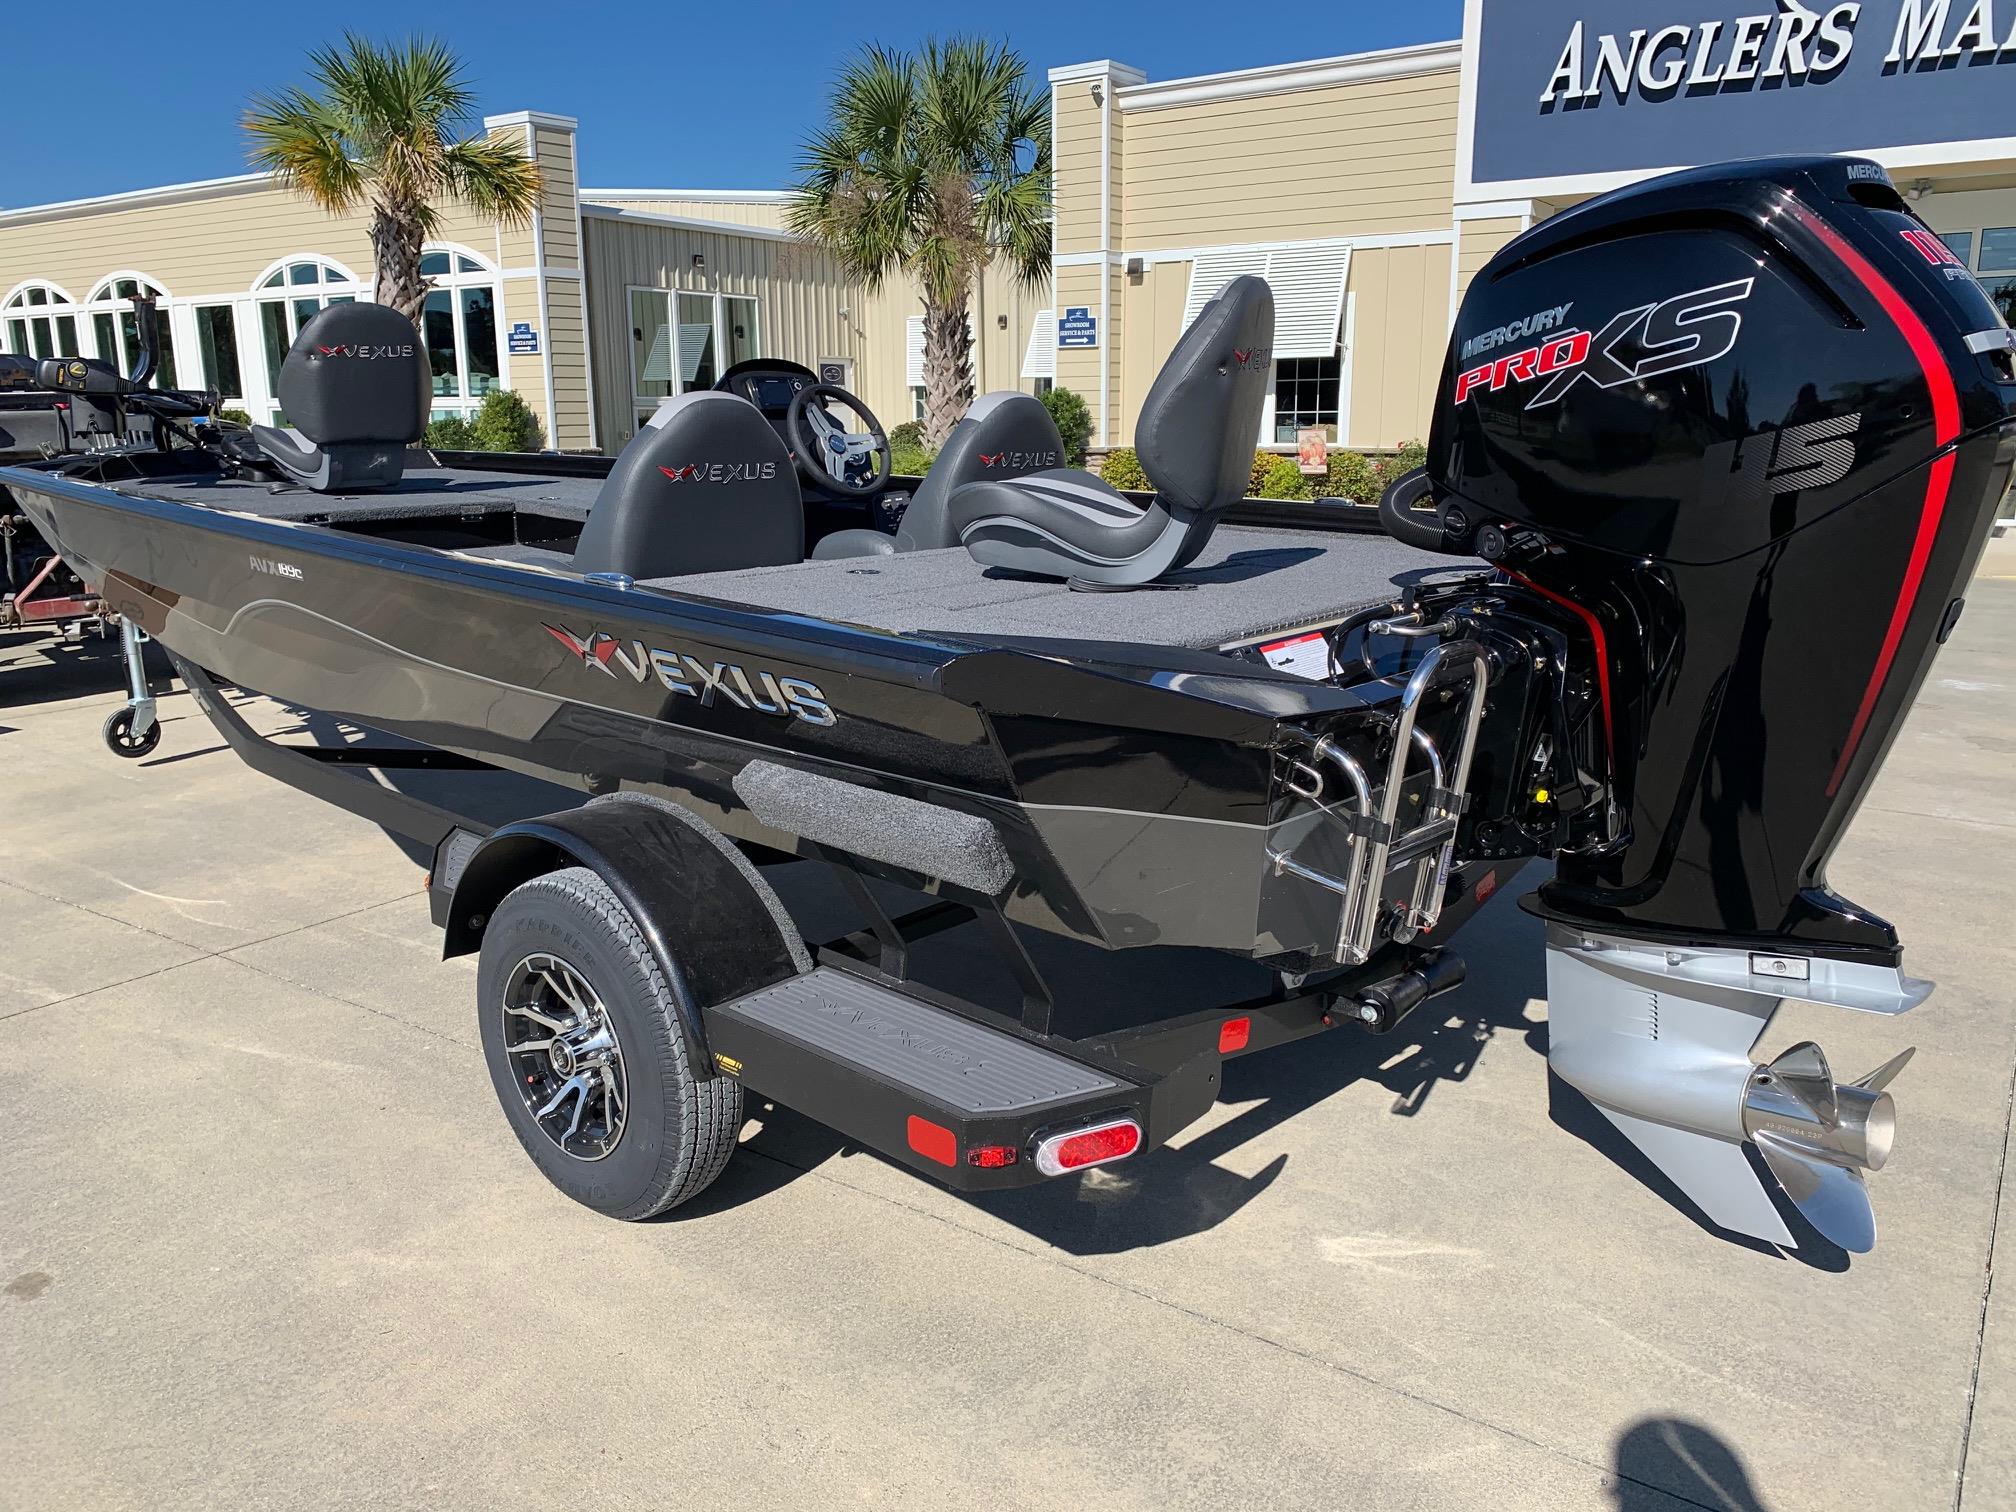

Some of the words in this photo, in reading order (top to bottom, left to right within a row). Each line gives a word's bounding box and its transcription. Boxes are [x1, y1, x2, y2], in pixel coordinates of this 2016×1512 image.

[1539, 3, 1862, 103] ANGLERS
[1884, 0, 2016, 62] MA
[343, 344, 414, 360] VEXUS
[1454, 331, 1593, 406] PRO
[1524, 277, 1756, 411] XS
[1462, 301, 1574, 360] MERCURY
[691, 462, 776, 484] VEXUS
[1001, 451, 1056, 469] VEXUS
[600, 632, 838, 727] VEXUS
